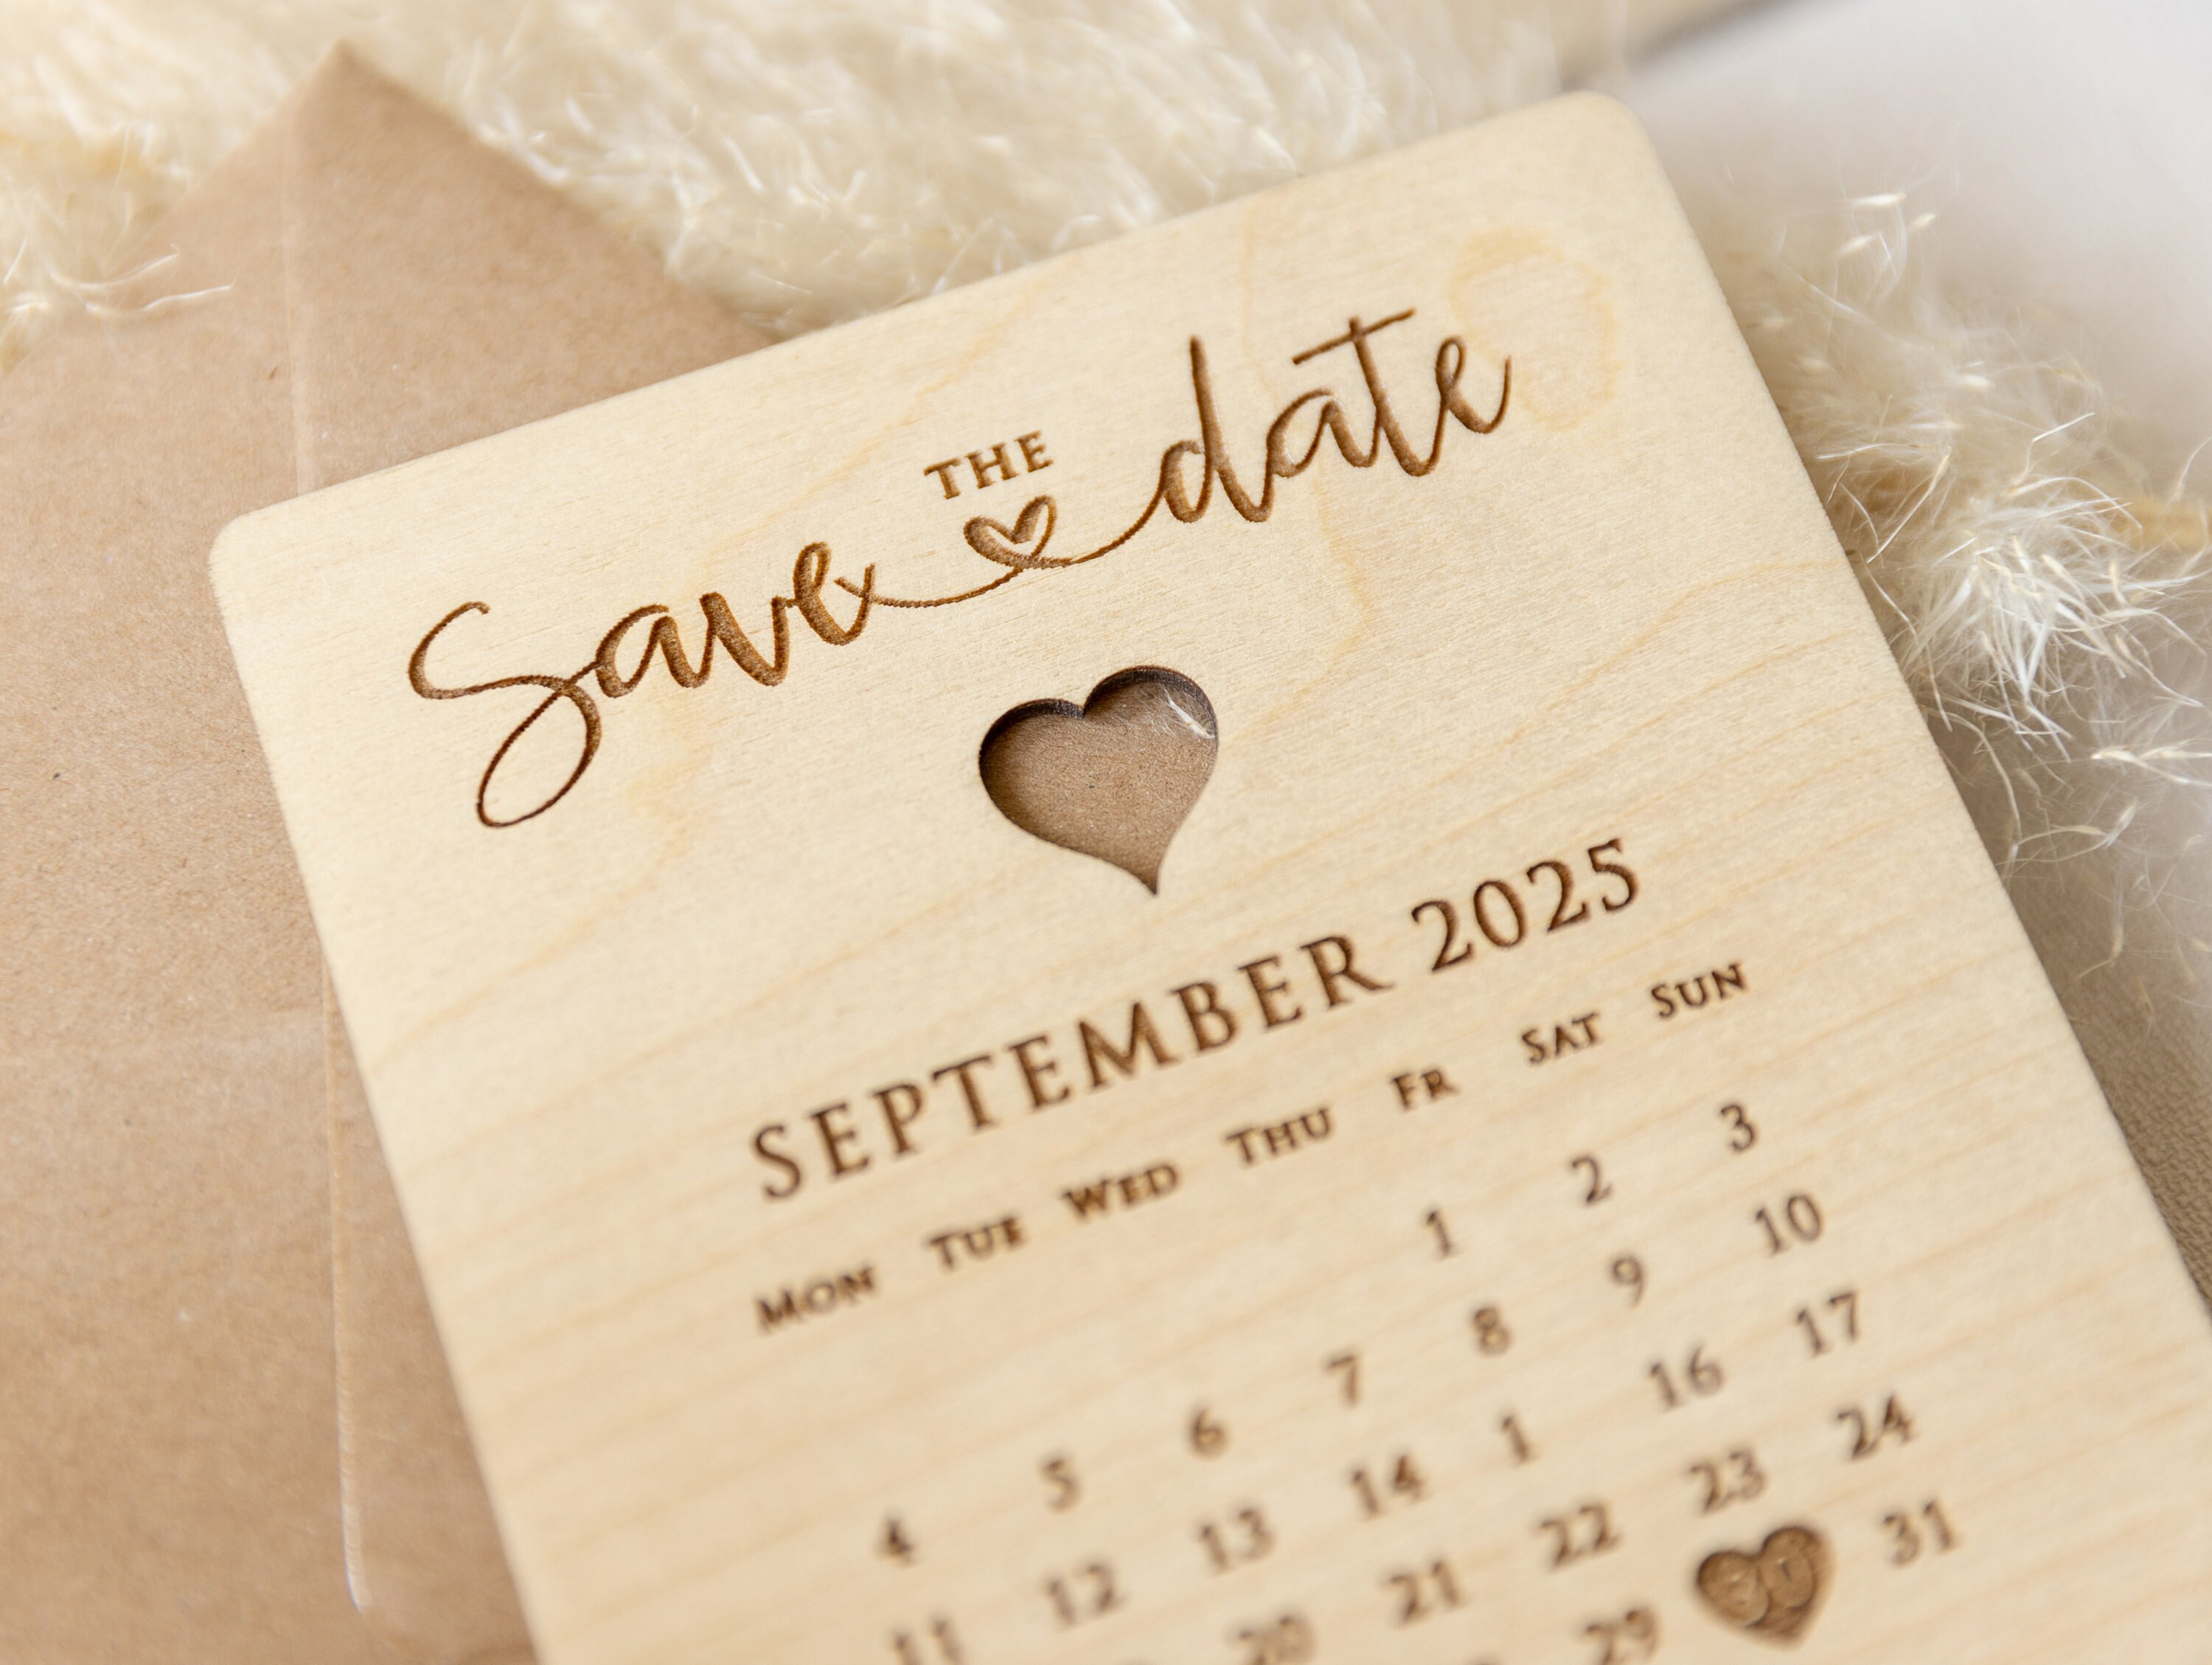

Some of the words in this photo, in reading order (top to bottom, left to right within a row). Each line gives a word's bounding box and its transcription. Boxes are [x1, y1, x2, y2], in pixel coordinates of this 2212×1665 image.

[408, 541, 877, 829] Save
[1153, 307, 1513, 524] date
[924, 431, 1054, 499] THE
[749, 934, 1395, 1202] SEPTEMBER
[1411, 839, 1637, 973] 2025
[757, 1265, 875, 1331] MON
[925, 1214, 1025, 1270] TUE
[1060, 1163, 1180, 1220] WED
[1225, 1107, 1332, 1164] THU
[1390, 1068, 1457, 1110] FR
[1521, 1012, 1599, 1063] SAT
[1651, 963, 1746, 1018] SUN
[1425, 1210, 1454, 1256] 1
[1570, 1155, 1610, 1205] 2
[1719, 1103, 1756, 1152] 3
[880, 1519, 914, 1563] 4
[1042, 1456, 1078, 1509] 5
[1188, 1408, 1226, 1456] 6
[1325, 1352, 1357, 1405] 7
[1471, 1306, 1510, 1354] 8
[1609, 1254, 1644, 1304] 9
[1755, 1193, 1821, 1254] 10
[1046, 1563, 1121, 1624] 12
[1199, 1506, 1271, 1570] 13
[1350, 1455, 1424, 1517] 14
[1500, 1415, 1534, 1463] 1
[1649, 1348, 1722, 1408] 16
[1795, 1290, 1857, 1355] 17
[1386, 1560, 1461, 1624] 21
[1537, 1503, 1618, 1568] 22
[1686, 1447, 1764, 1513] 23
[1835, 1395, 1913, 1459] 24
[1882, 1500, 1955, 1565] 31
